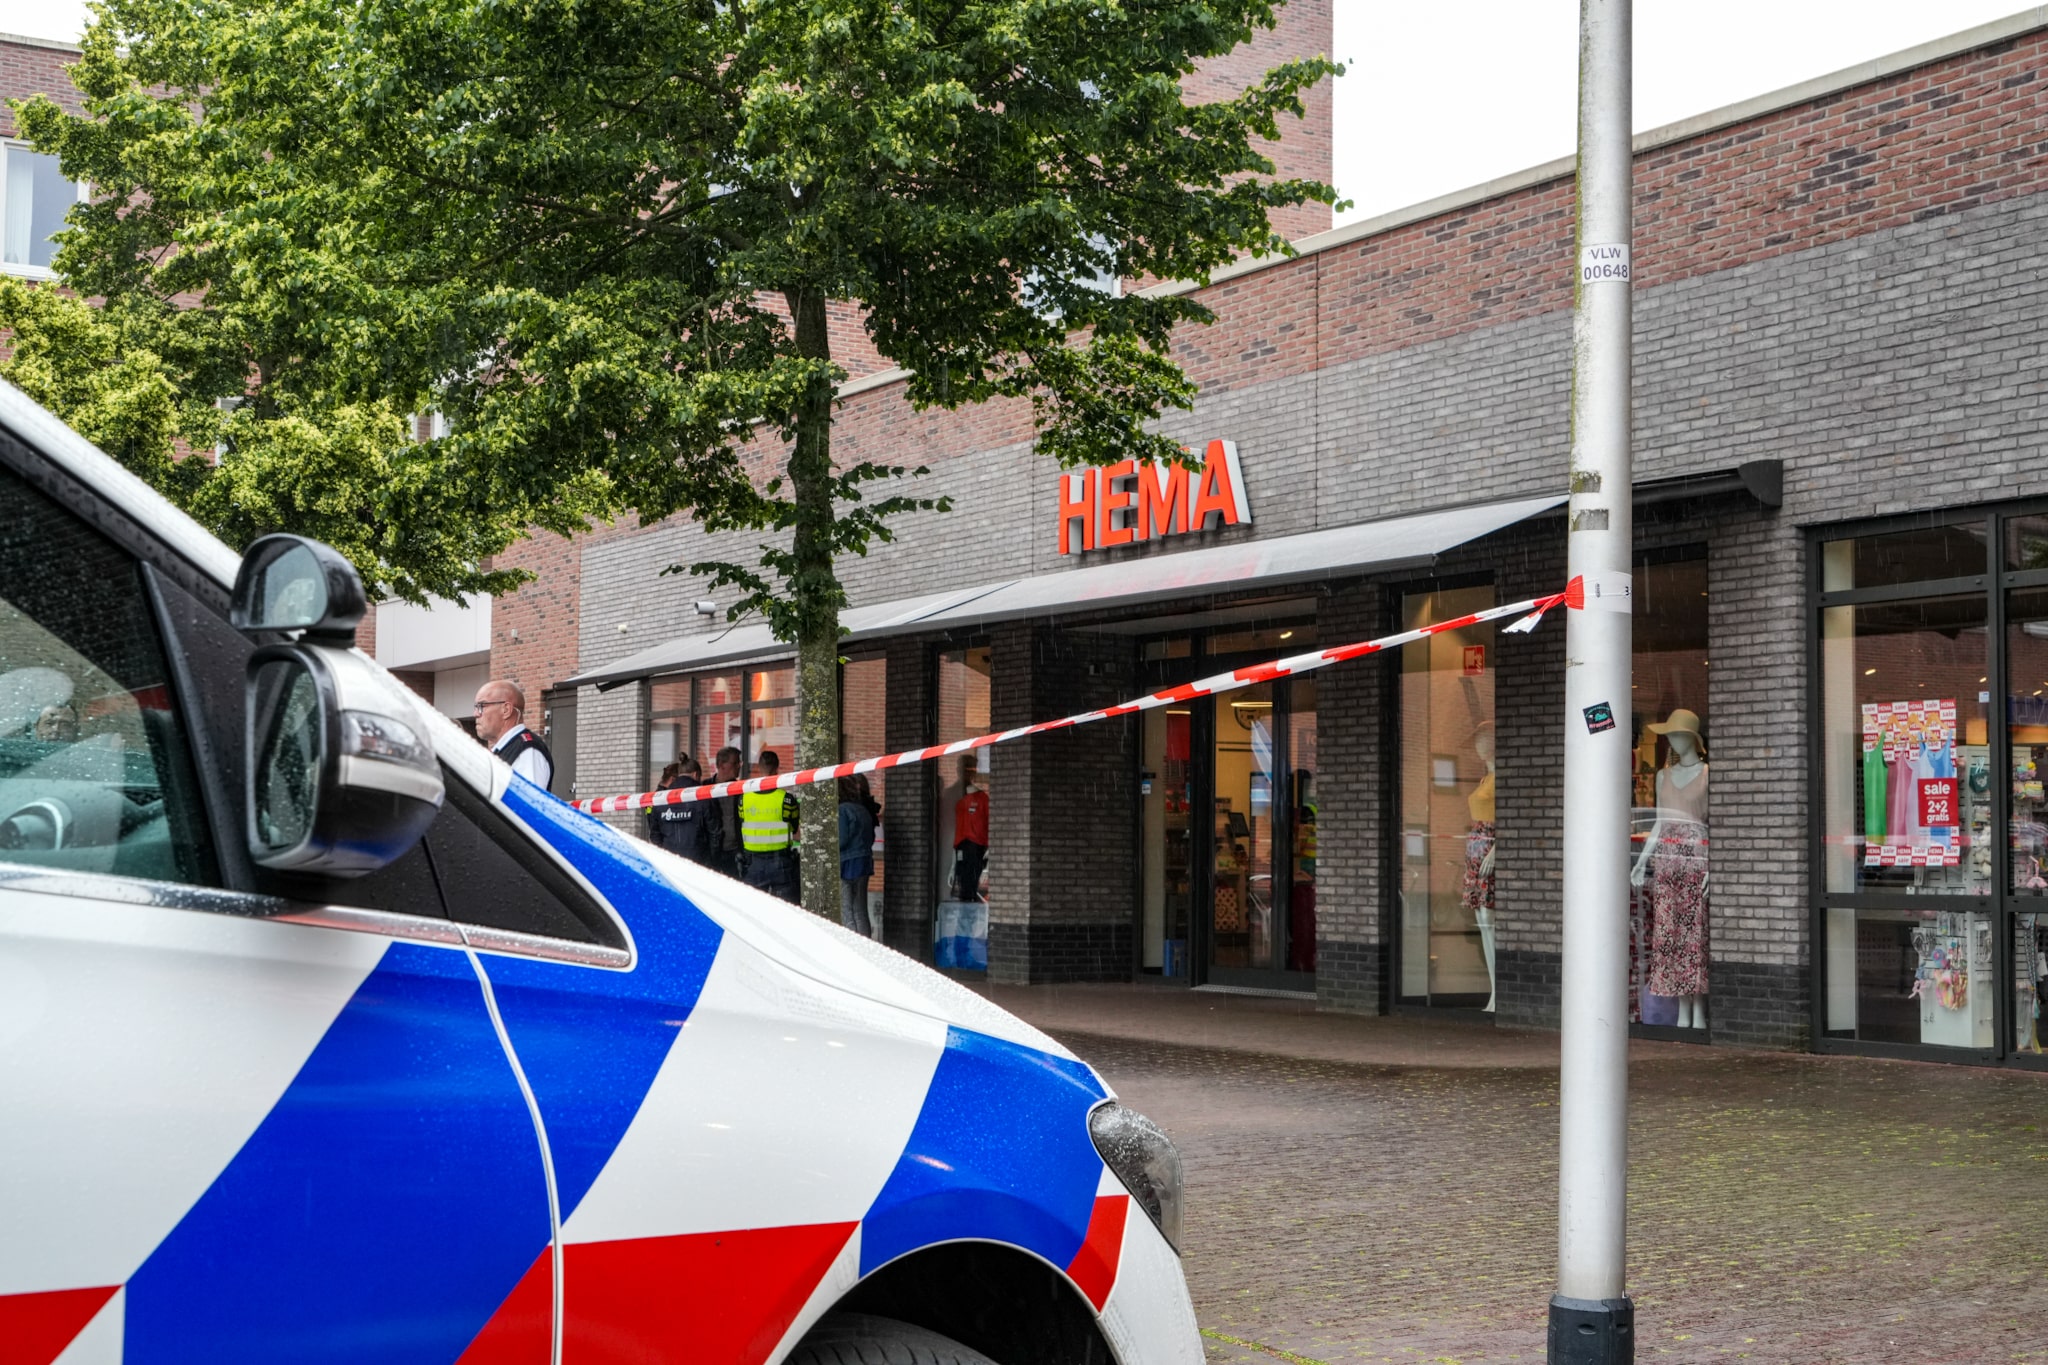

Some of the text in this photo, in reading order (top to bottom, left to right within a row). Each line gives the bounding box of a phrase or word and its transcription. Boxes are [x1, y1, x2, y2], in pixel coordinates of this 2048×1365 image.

[1591, 247, 1621, 259] VLW
[1584, 264, 1628, 280] 00648
[1058, 439, 1251, 555] HEMA
[1924, 780, 1950, 795] sale
[1927, 800, 1948, 813] 2+2
[661, 807, 692, 821] POLITIE
[1926, 813, 1950, 824] gratis
